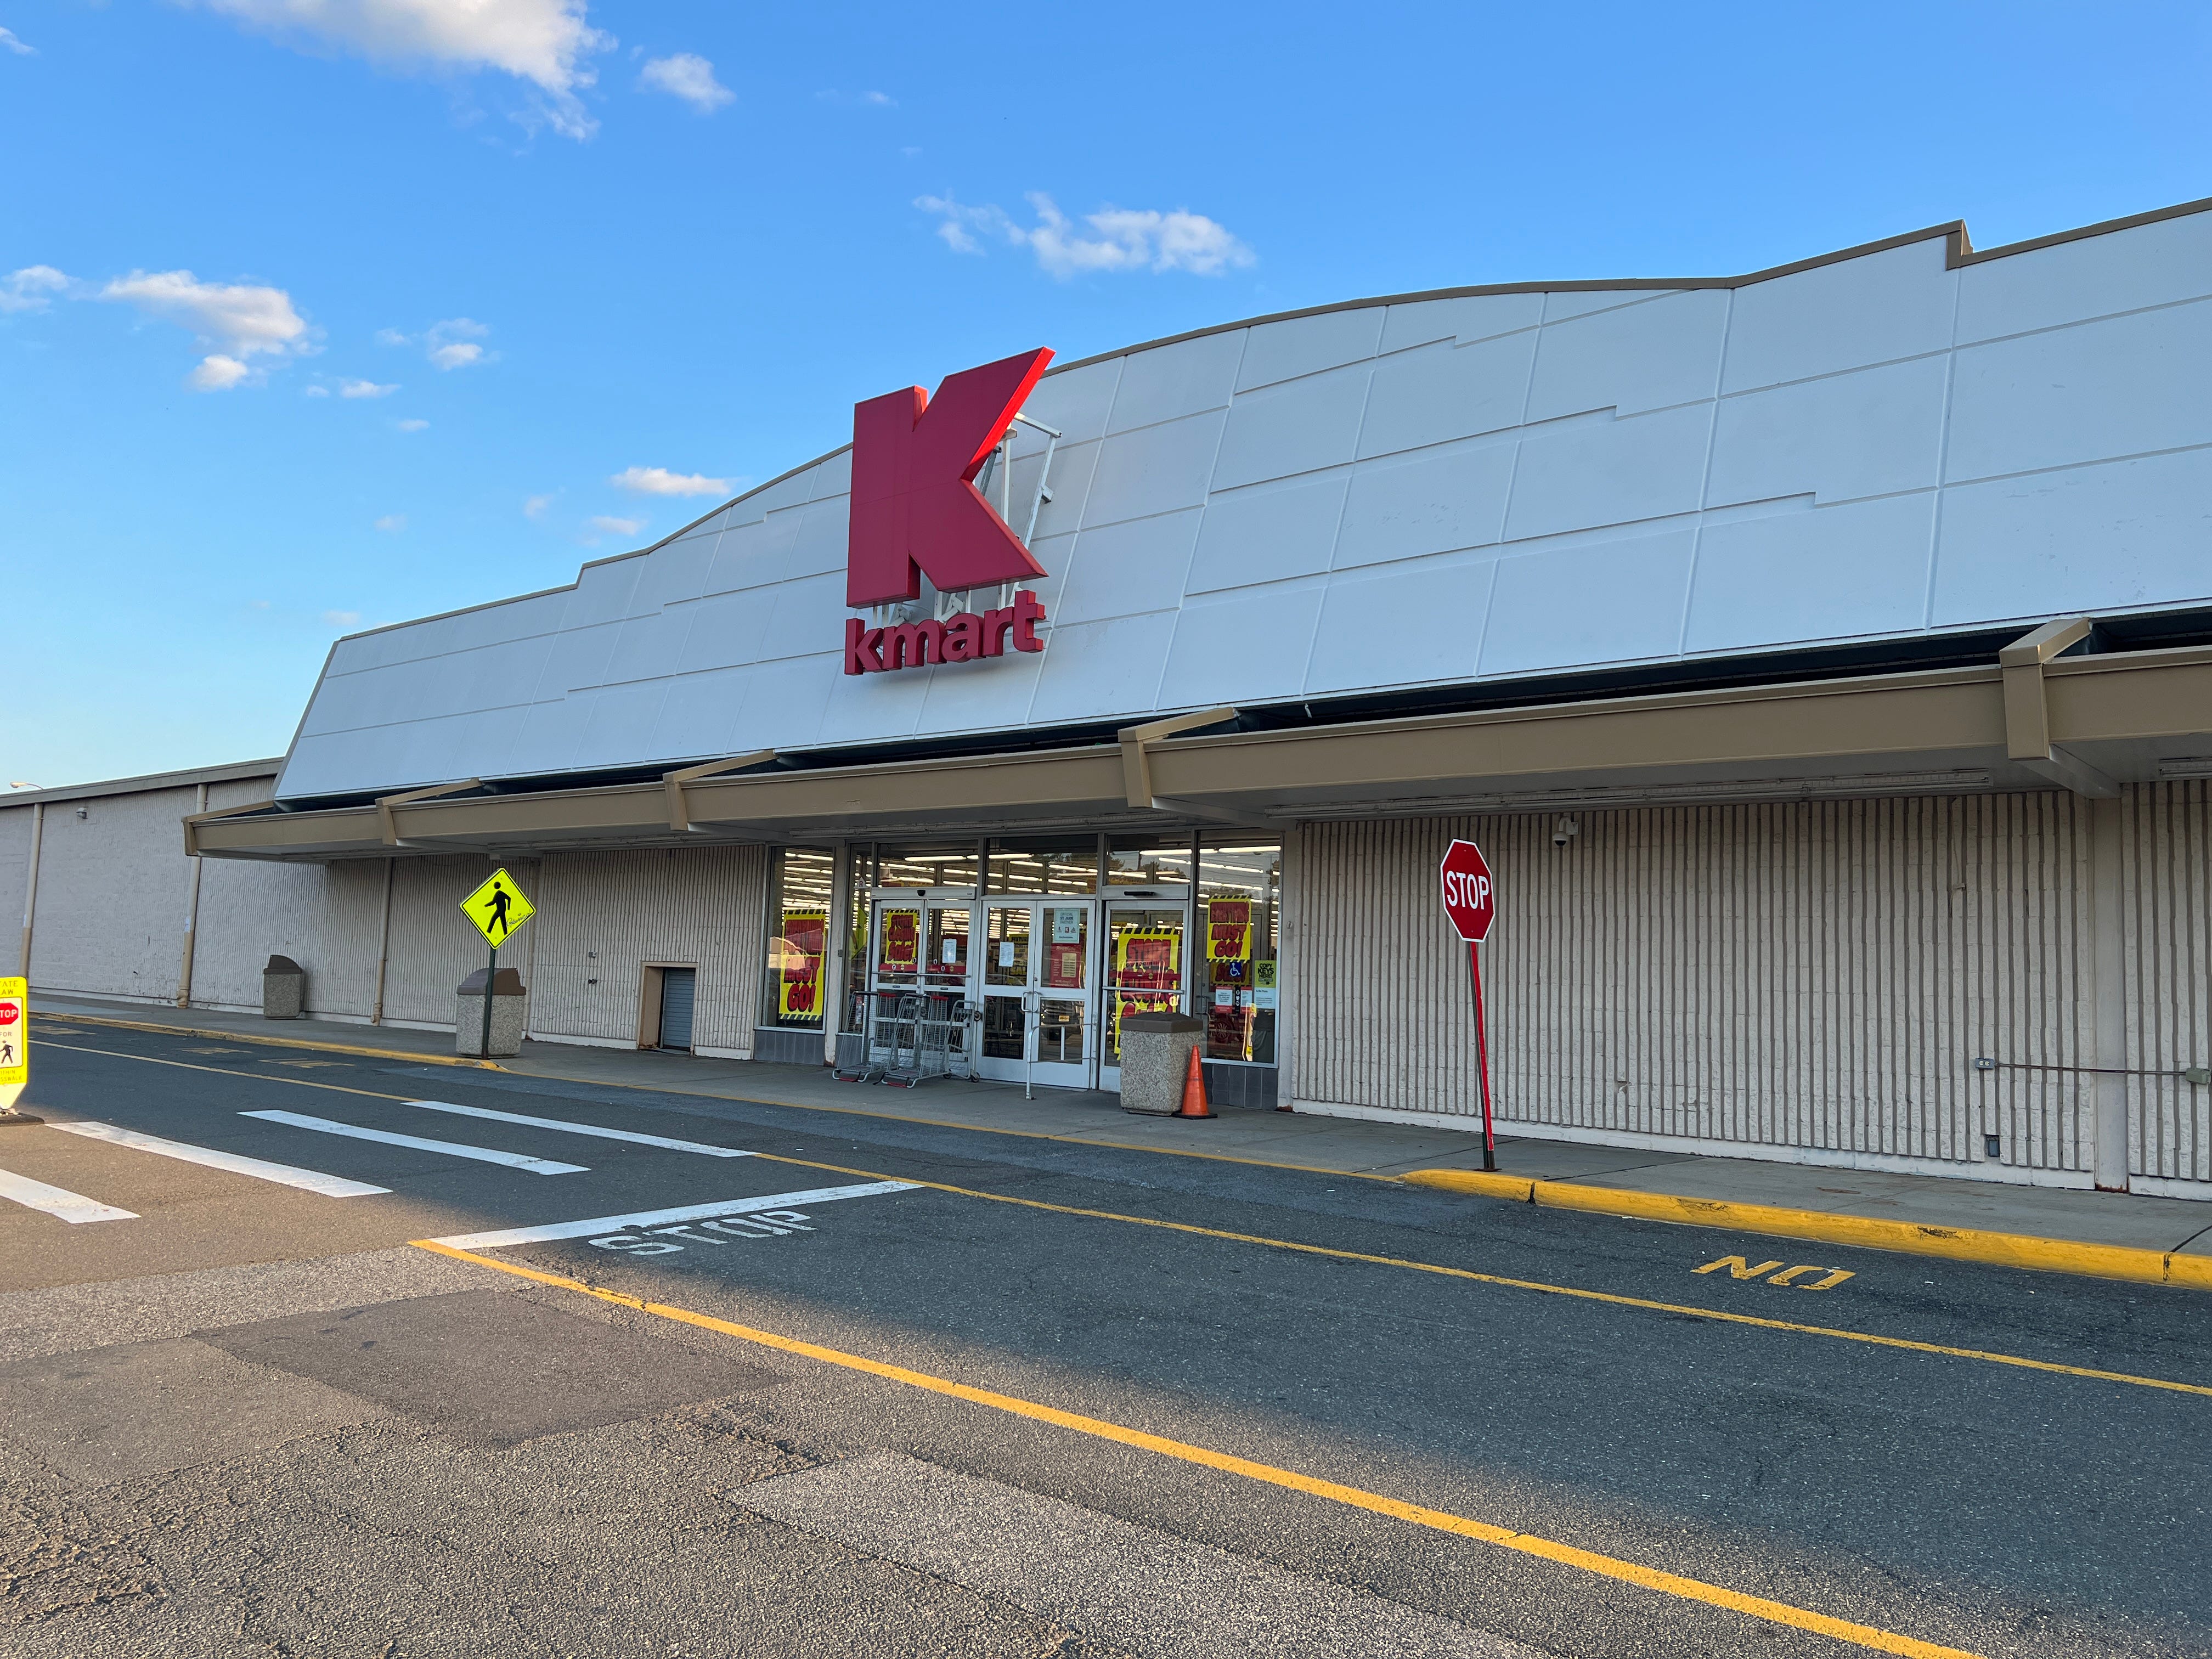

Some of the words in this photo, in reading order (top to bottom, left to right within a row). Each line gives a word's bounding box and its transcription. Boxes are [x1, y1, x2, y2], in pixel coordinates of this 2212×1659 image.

[847, 347, 1056, 608] K
[845, 590, 1045, 675] kmart
[1446, 870, 1489, 910] STOP
[1211, 924, 1247, 941] MUST
[1215, 940, 1243, 958] GO!
[1126, 938, 1171, 969] STORE
[787, 984, 816, 1012] GO!
[588, 1210, 818, 1255] STOP
[1690, 1255, 1857, 1290] NO
